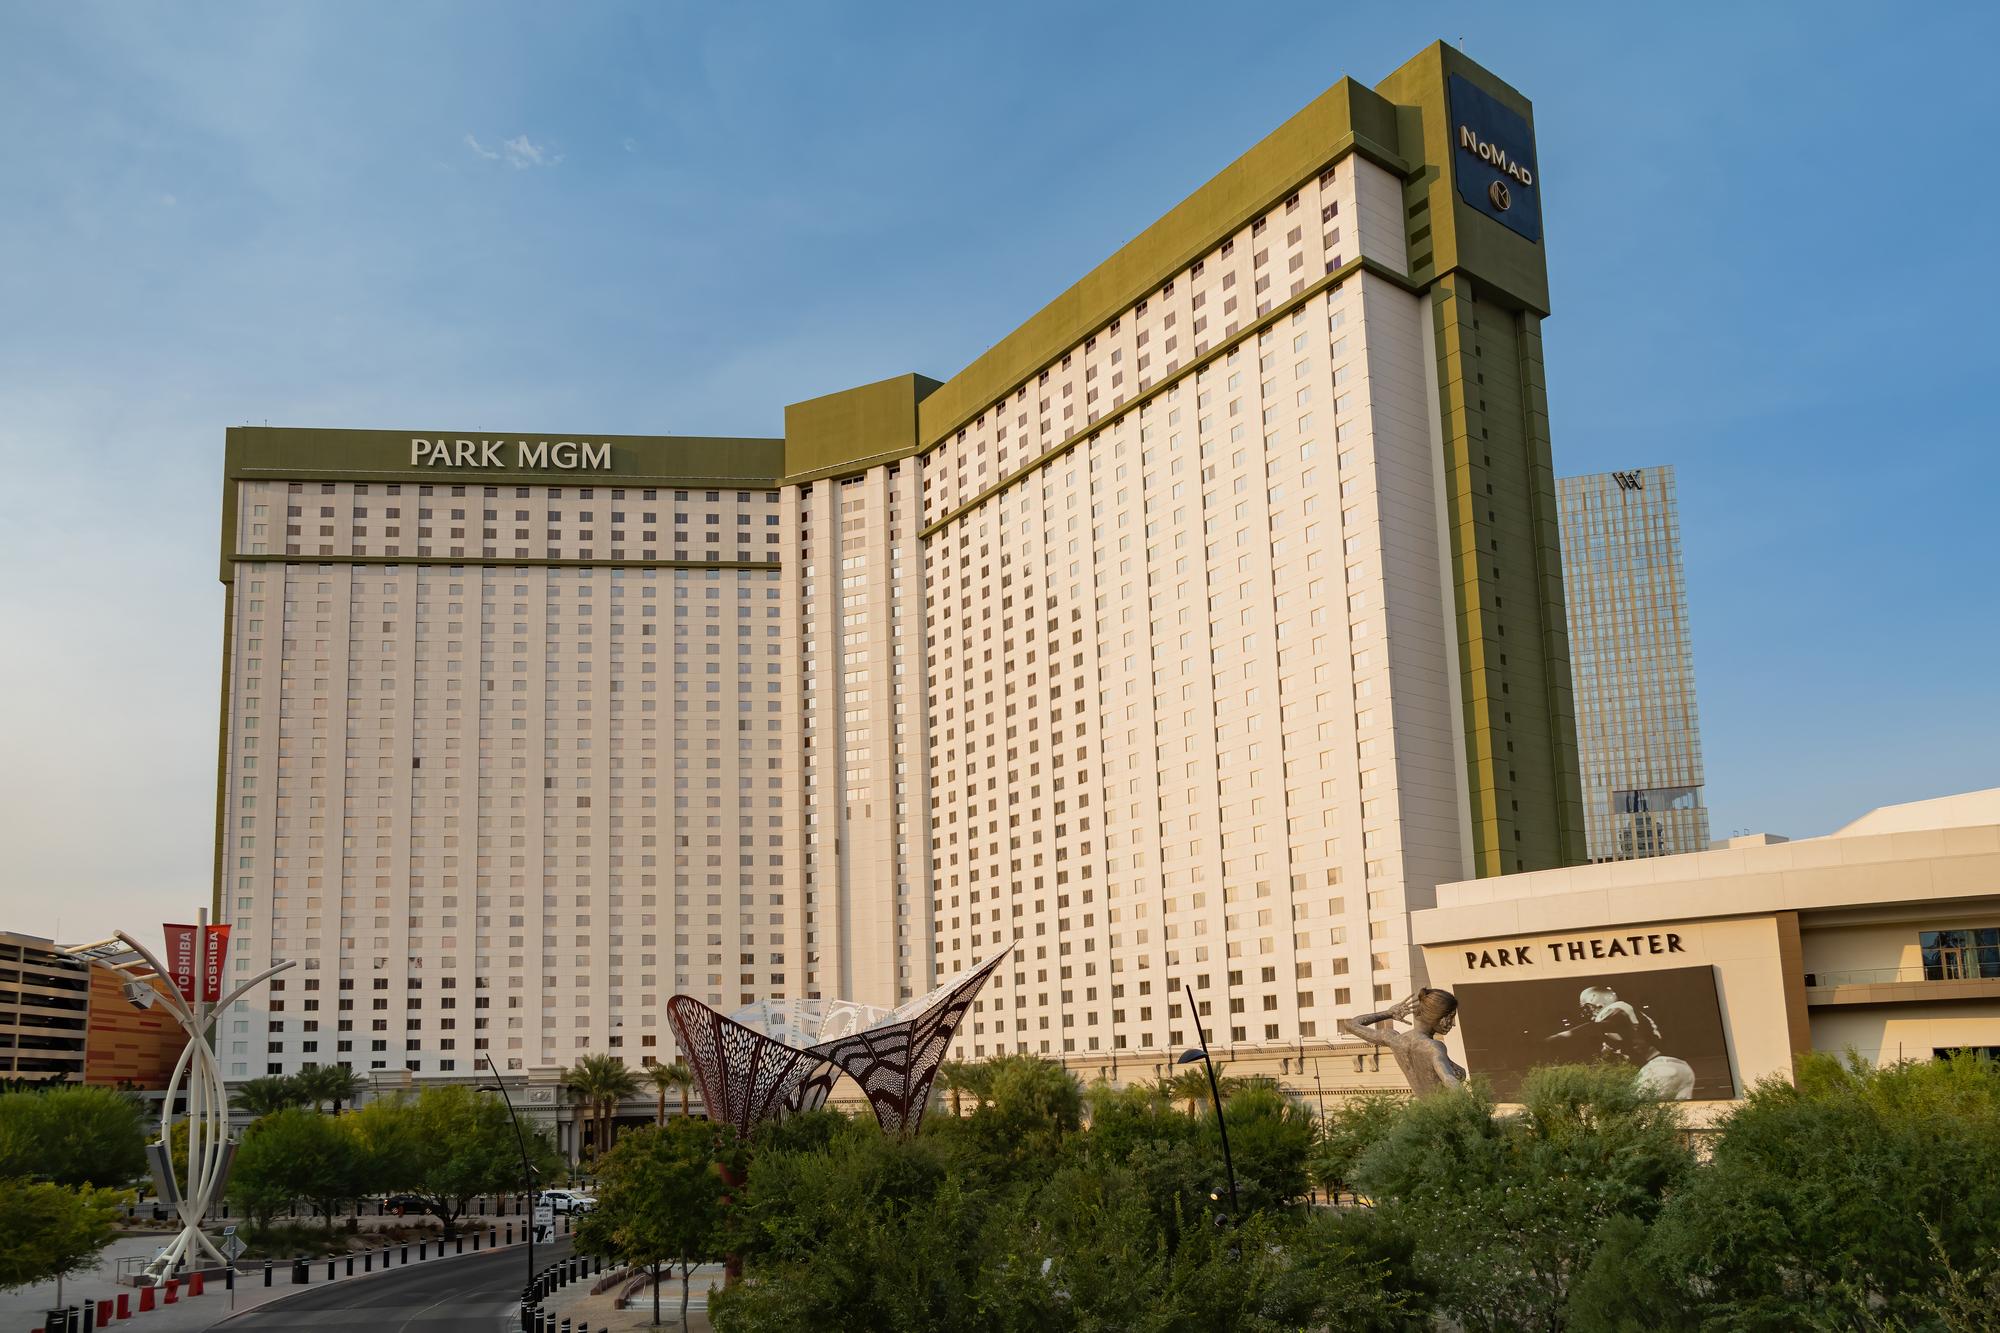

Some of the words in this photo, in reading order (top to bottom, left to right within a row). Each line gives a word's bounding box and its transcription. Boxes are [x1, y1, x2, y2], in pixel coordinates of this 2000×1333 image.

[410, 438, 505, 467] PARK
[517, 440, 612, 470] MGM
[178, 931, 192, 993] TOSHIBA
[208, 931, 219, 995] TOSHIBA
[1465, 945, 1534, 970] PARK
[1548, 932, 1686, 962] THEATER
